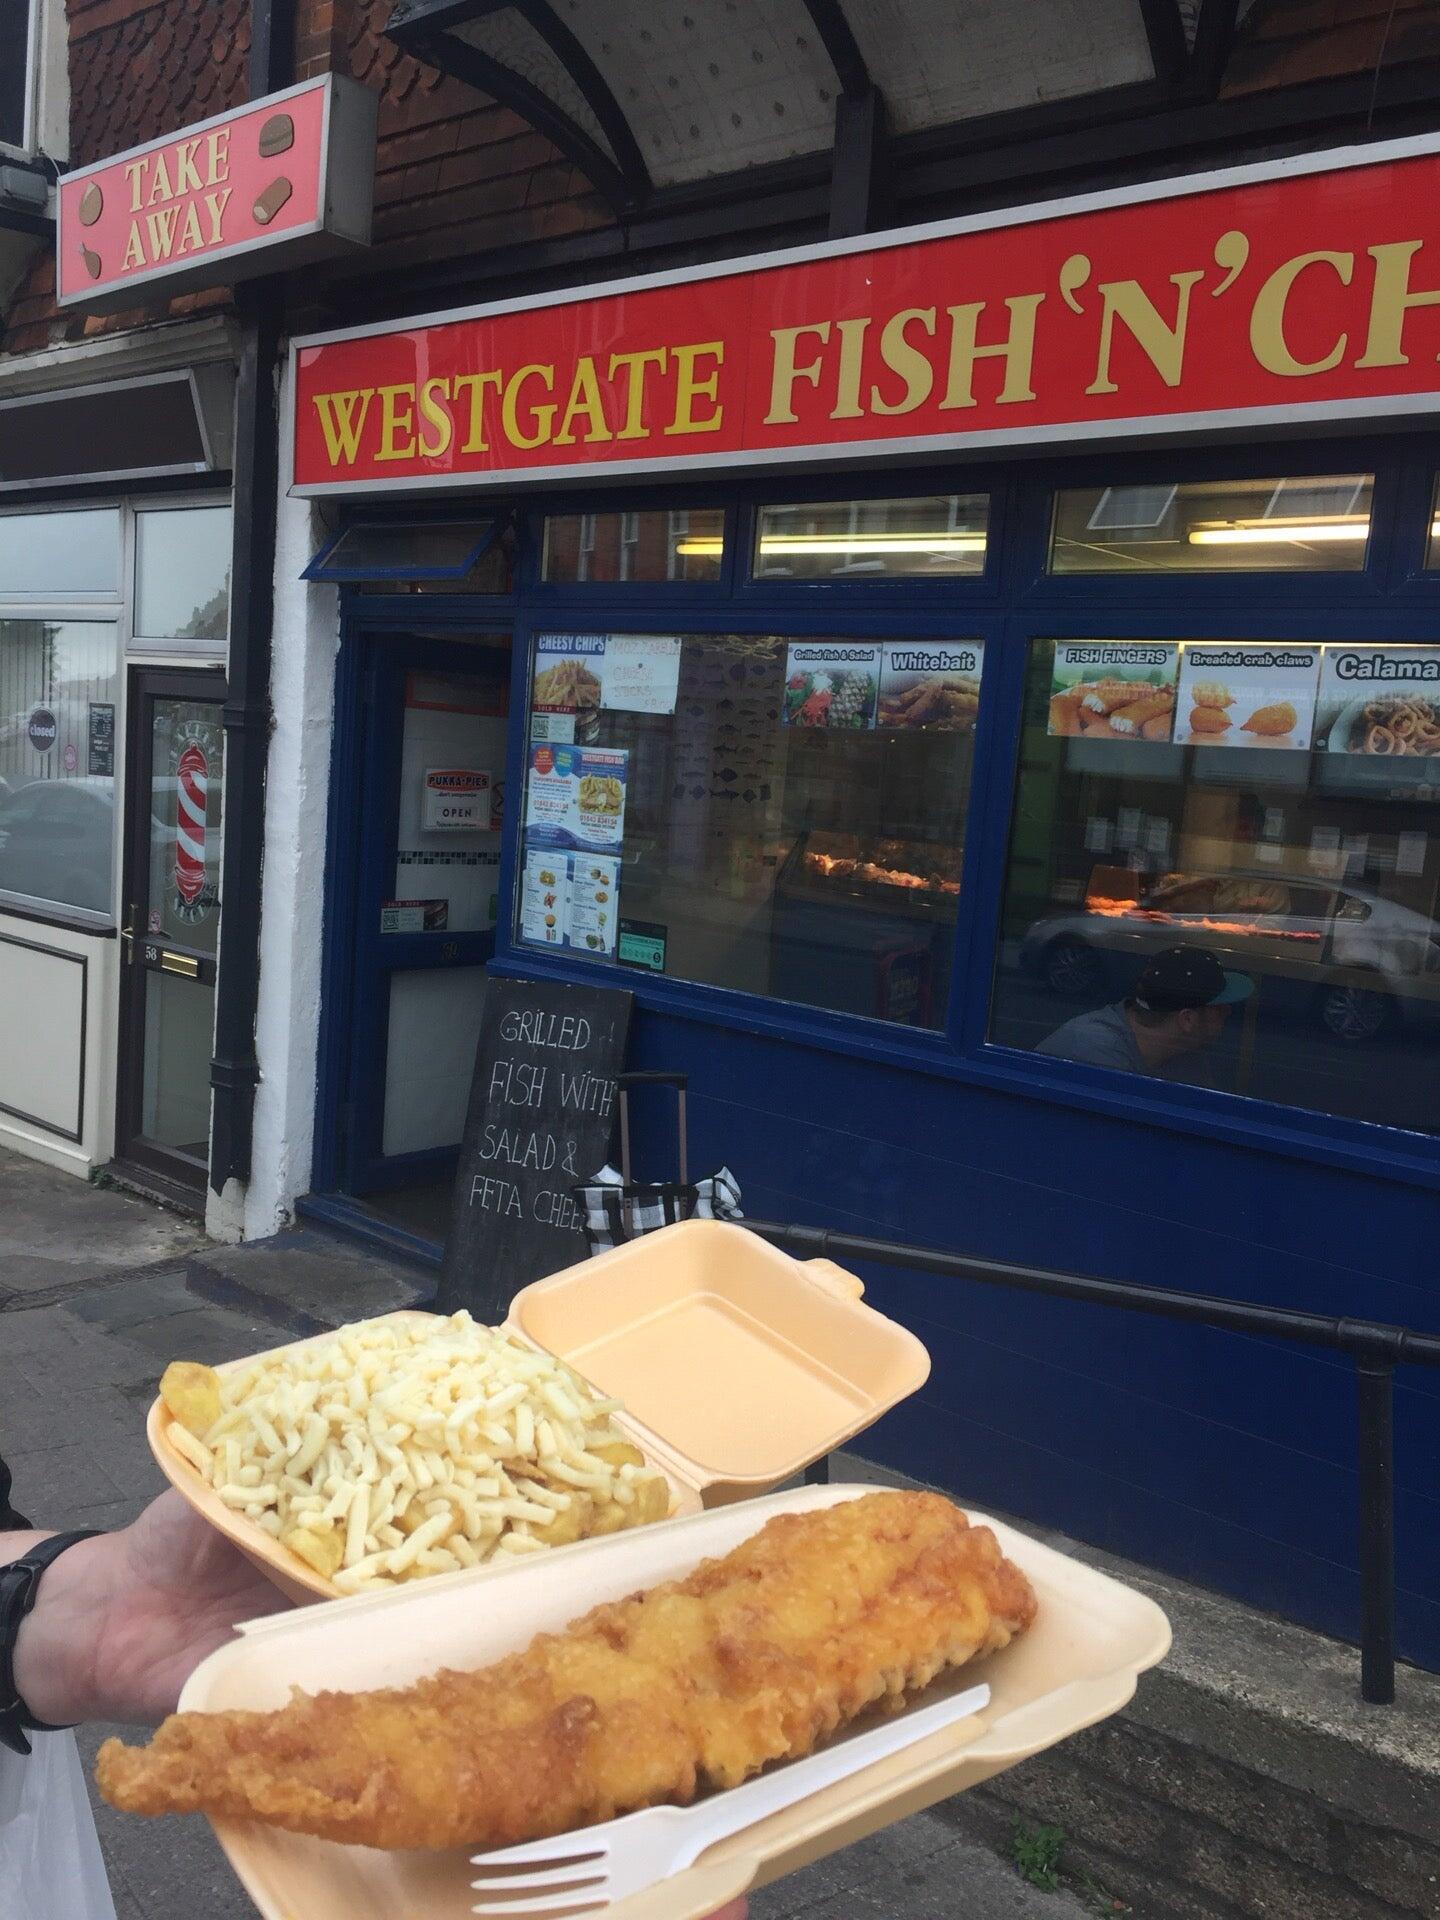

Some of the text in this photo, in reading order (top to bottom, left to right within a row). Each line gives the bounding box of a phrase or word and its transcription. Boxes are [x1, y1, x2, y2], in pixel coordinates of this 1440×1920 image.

[125, 127, 232, 212] TAKE
[121, 189, 232, 272] AWAY
[312, 341, 725, 467] WESTGATE
[538, 634, 573, 650] CHEESY
[574, 635, 605, 652] CHIPS
[794, 649, 875, 662] Grilled fish & Salad
[891, 651, 976, 671] Whitebait
[1065, 649, 1168, 665] FISH FINGERS
[1190, 652, 1313, 668] Breaded crab claws
[30, 725, 55, 737] closed
[442, 808, 473, 818] OPEN
[146, 946, 157, 961] 58
[500, 1008, 591, 1050] GRILLED
[488, 1057, 617, 1116] FISH WITH
[479, 1124, 579, 1178] SALAD &
[469, 1174, 523, 1219] FETA
